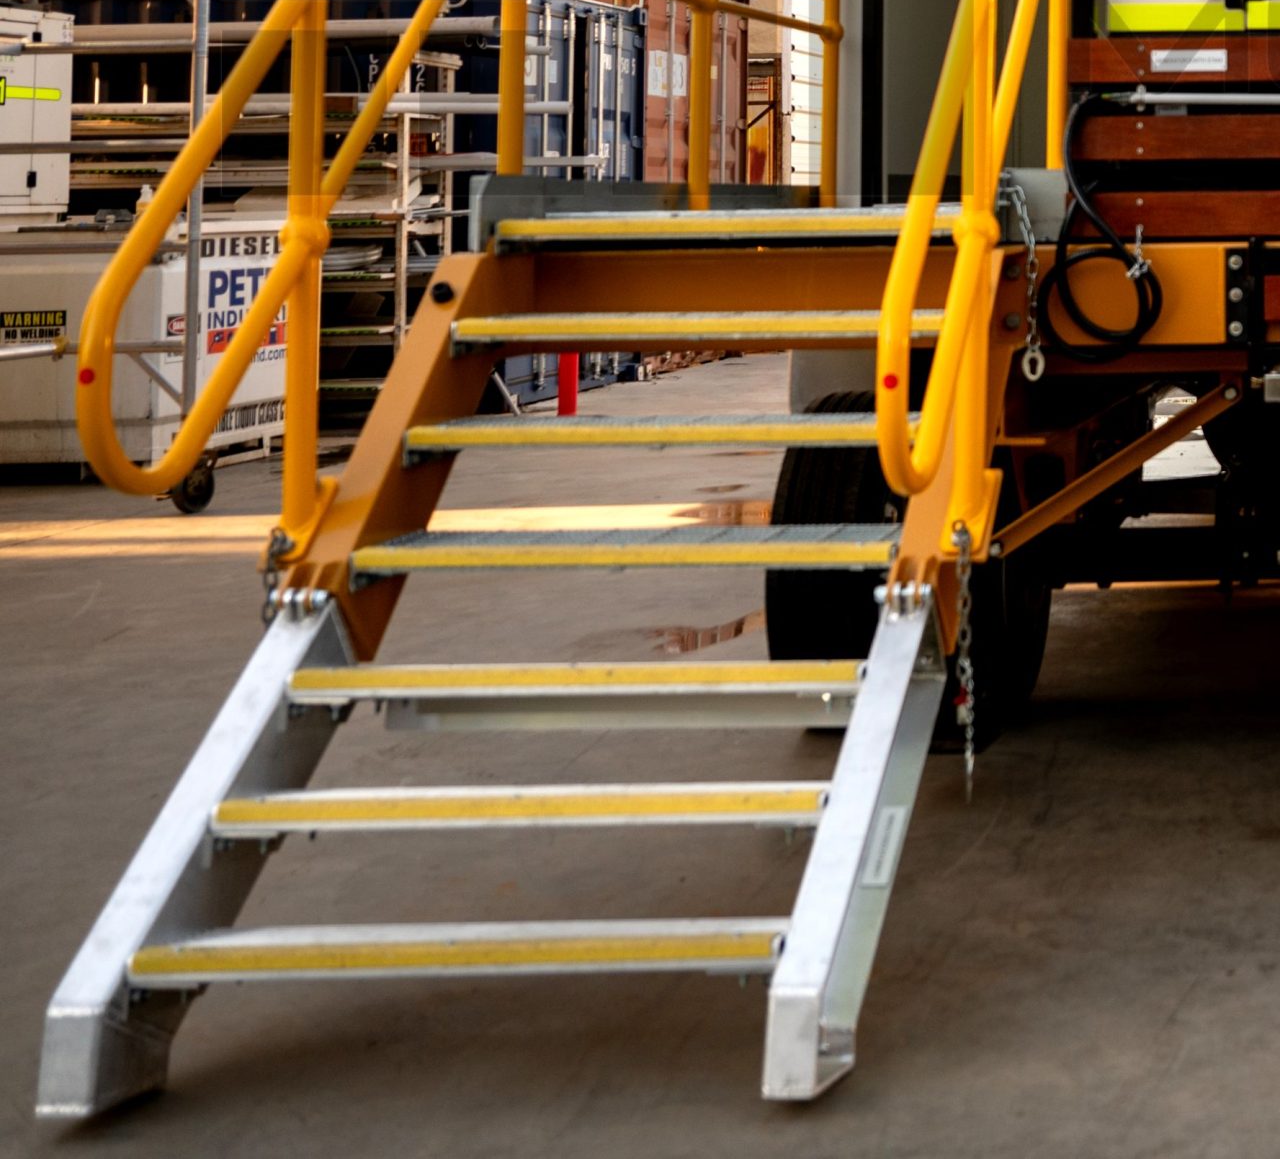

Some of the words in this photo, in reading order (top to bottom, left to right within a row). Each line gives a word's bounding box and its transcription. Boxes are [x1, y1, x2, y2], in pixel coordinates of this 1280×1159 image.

[208, 267, 272, 309] PET
[4, 311, 63, 327] WARNING
[5, 329, 17, 340] NO
[20, 328, 60, 339] WELDING
